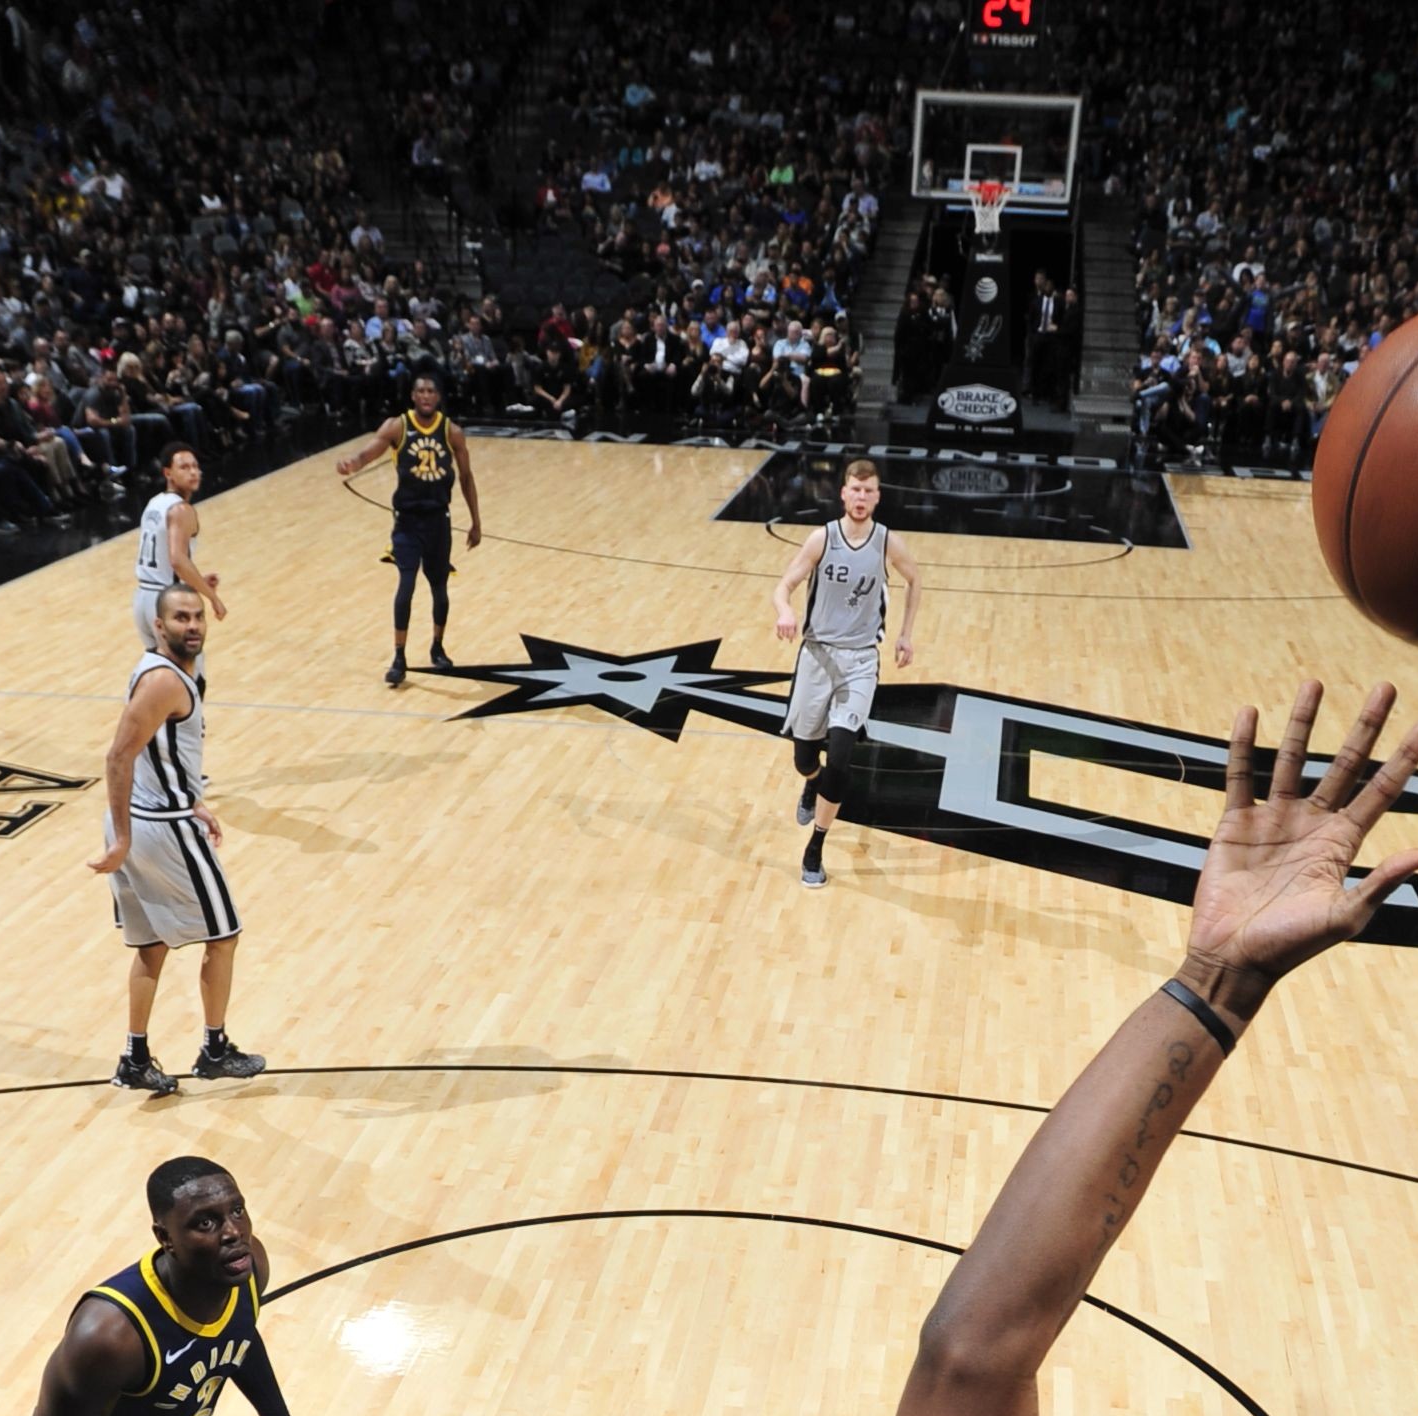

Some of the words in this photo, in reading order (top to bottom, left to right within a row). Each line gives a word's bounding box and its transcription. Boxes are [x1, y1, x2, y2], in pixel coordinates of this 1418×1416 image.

[956, 391, 1000, 403] BRAKE
[955, 403, 998, 414] CHECK
[418, 449, 437, 472] 21
[824, 564, 849, 583] 42
